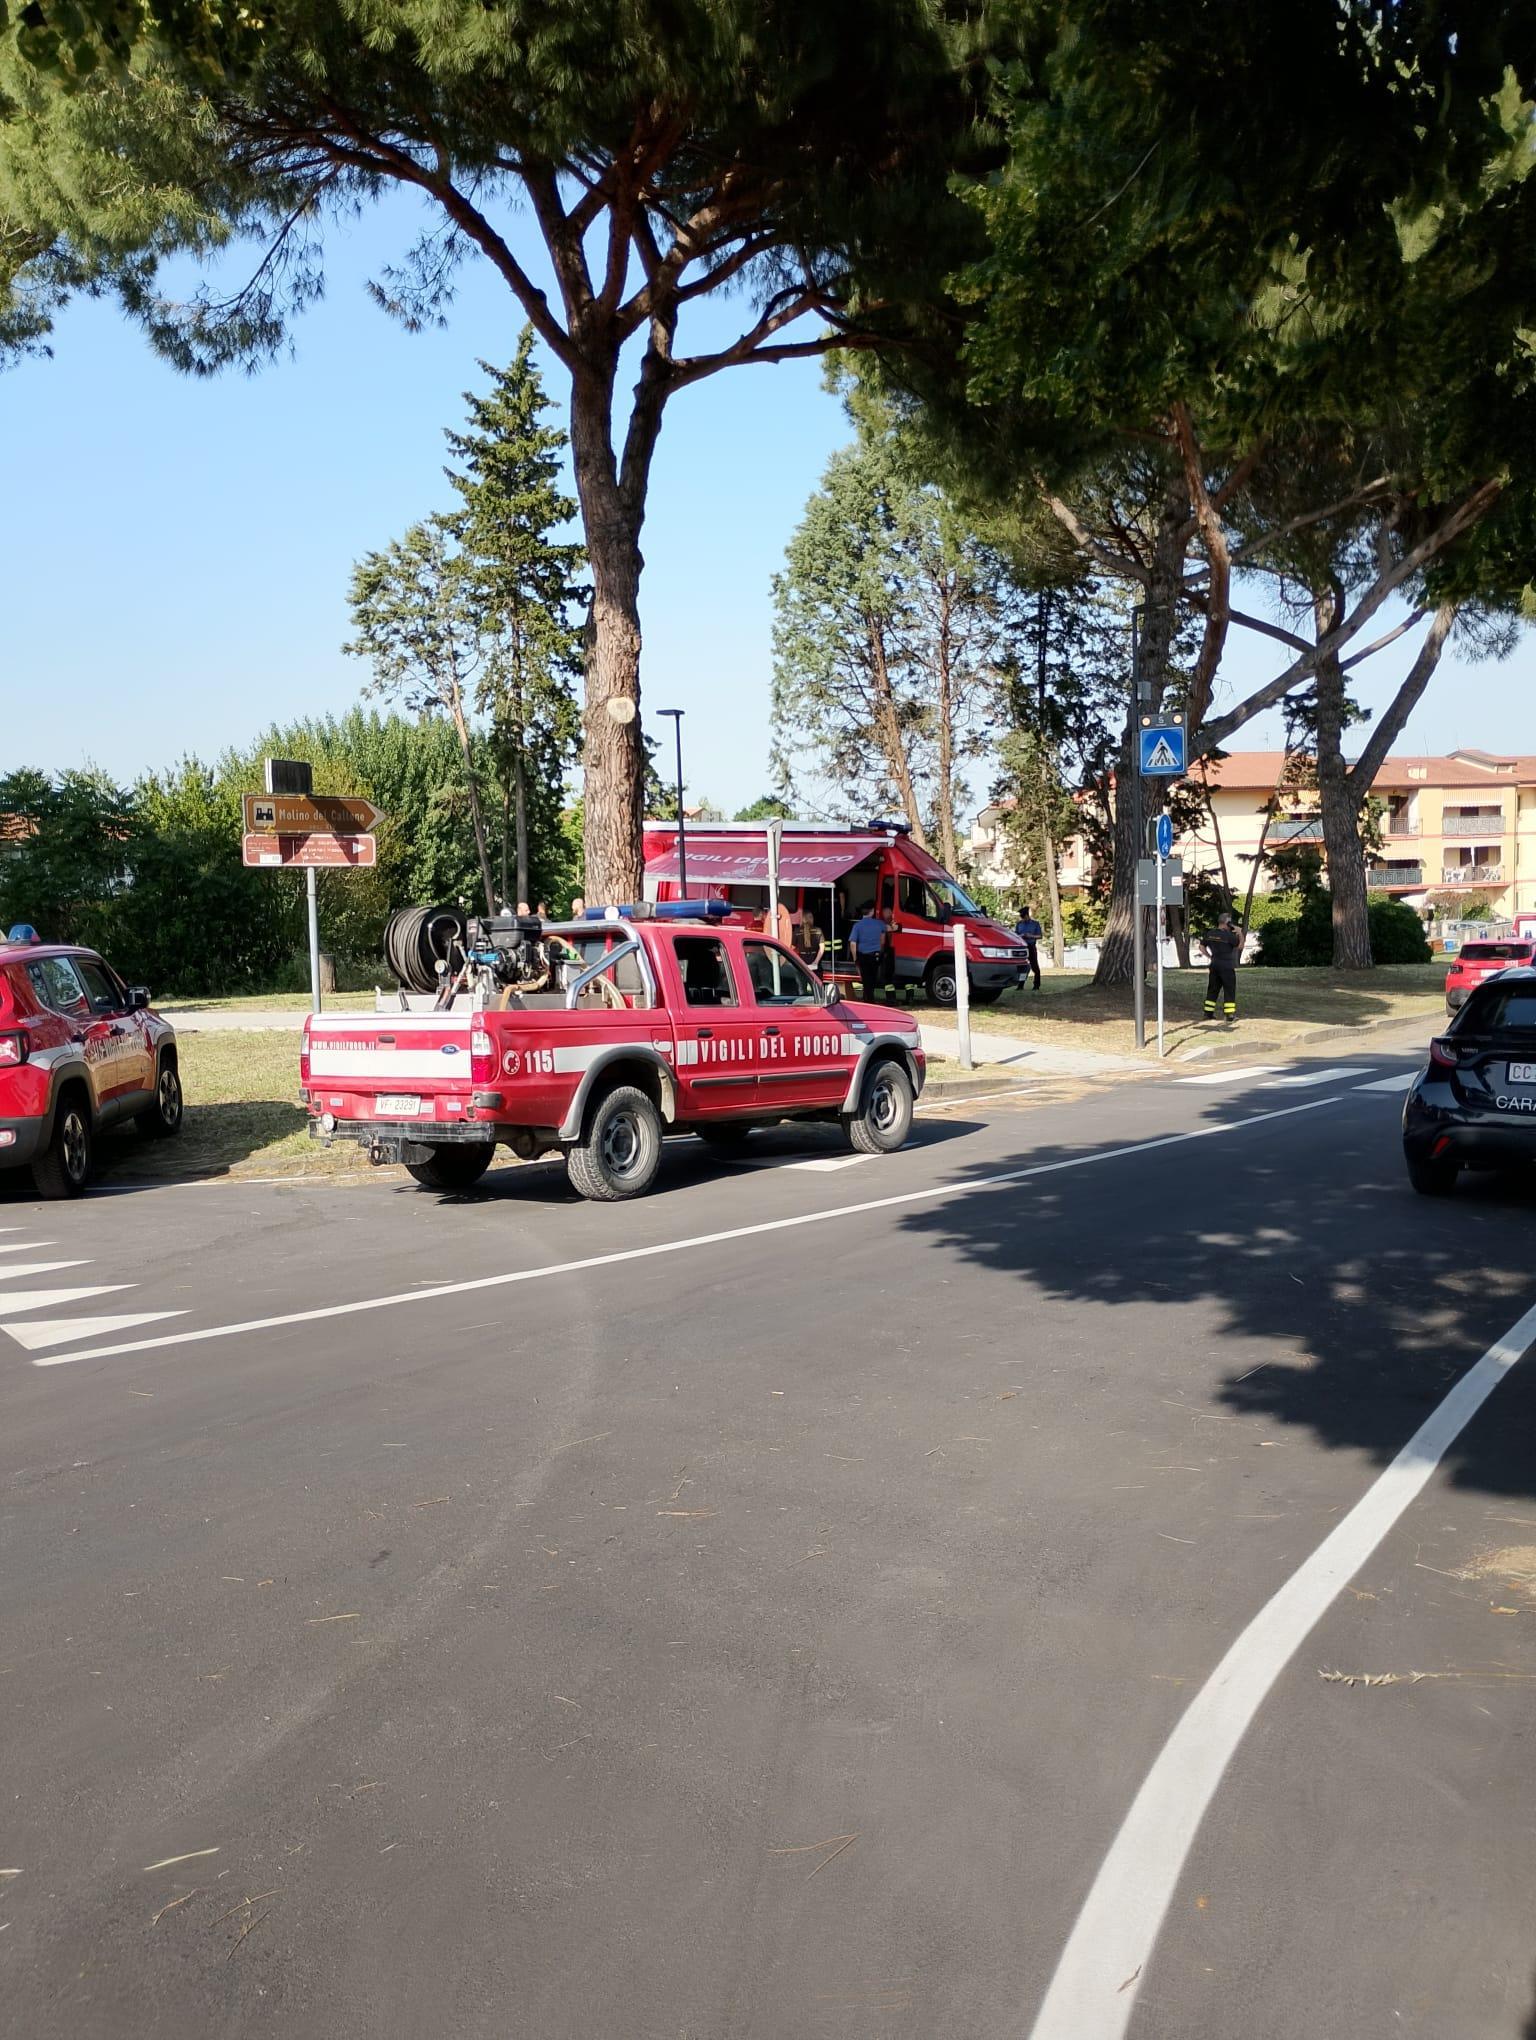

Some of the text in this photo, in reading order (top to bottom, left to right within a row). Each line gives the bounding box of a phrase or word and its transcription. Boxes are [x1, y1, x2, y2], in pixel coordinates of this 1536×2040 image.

[279, 808, 310, 821] Molino
[780, 855, 855, 864] FUOCO
[700, 1035, 839, 1063] VIGILI DEL FUOCO
[524, 1050, 552, 1073] 115
[1513, 1066, 1532, 1080] CC
